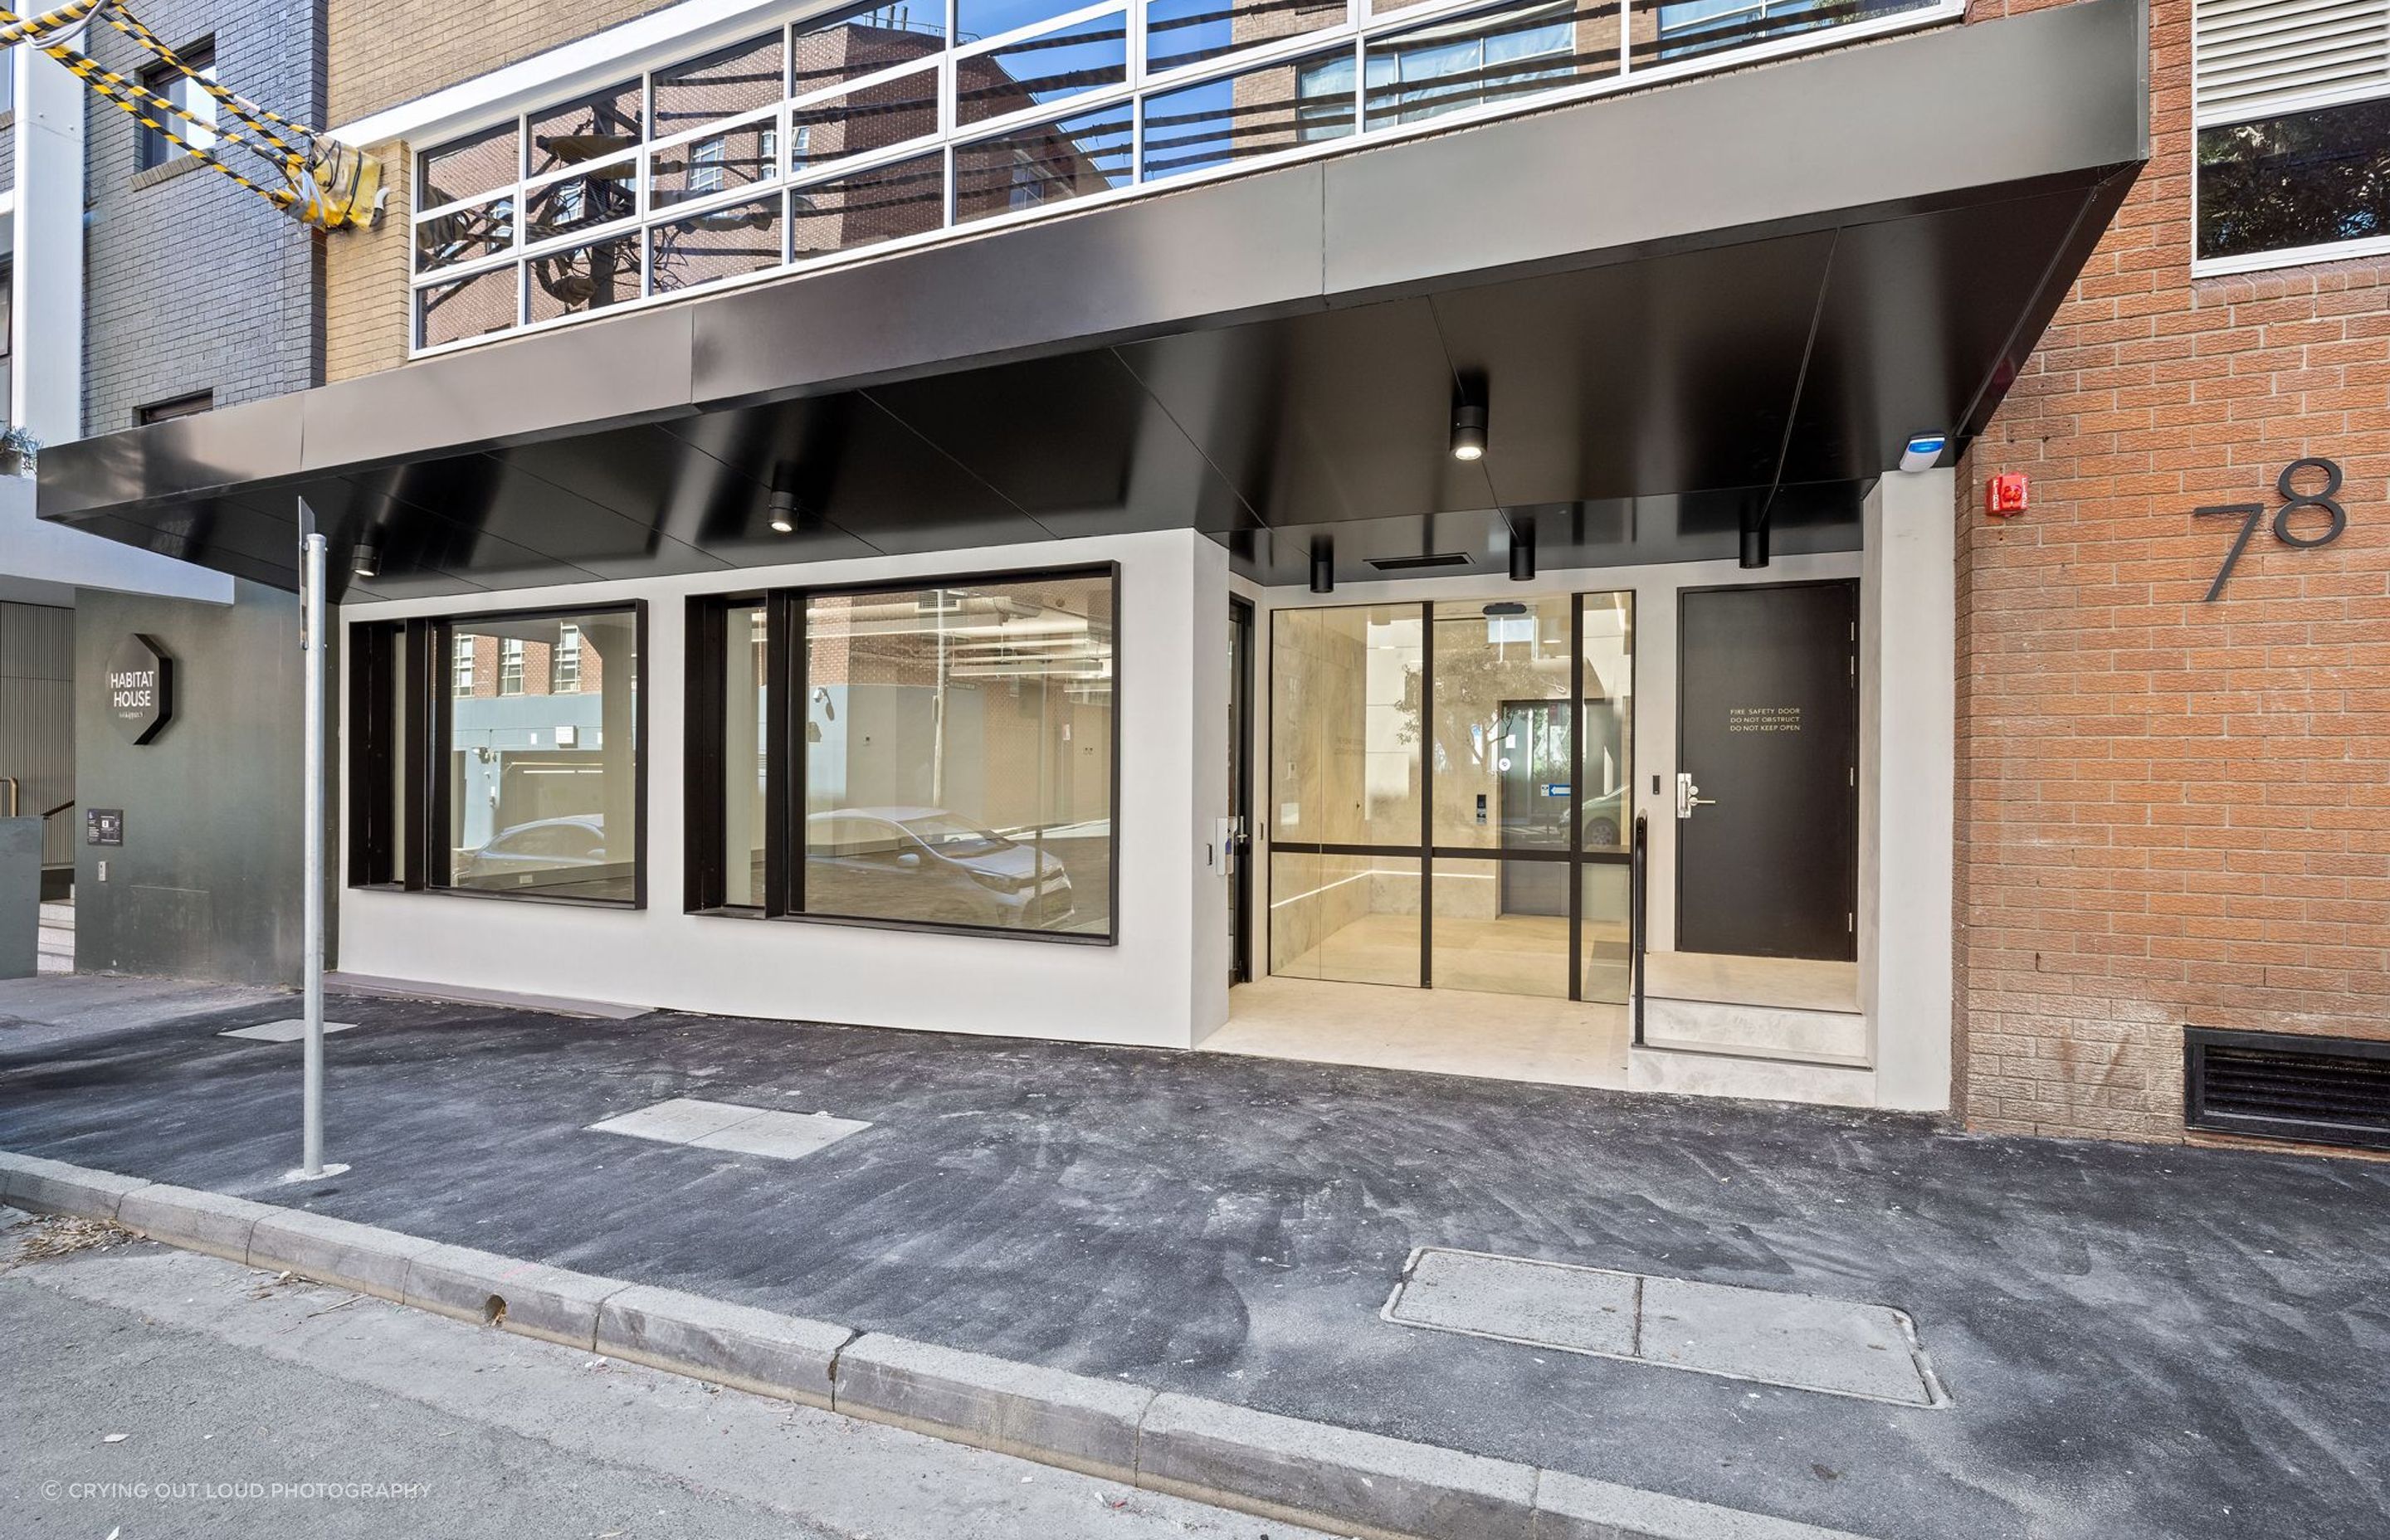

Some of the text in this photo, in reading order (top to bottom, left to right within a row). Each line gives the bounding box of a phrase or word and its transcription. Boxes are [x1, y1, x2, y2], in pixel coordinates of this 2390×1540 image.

[2192, 457, 2346, 602] 78
[110, 670, 154, 689] HABITAT
[114, 690, 151, 708] HOUSE
